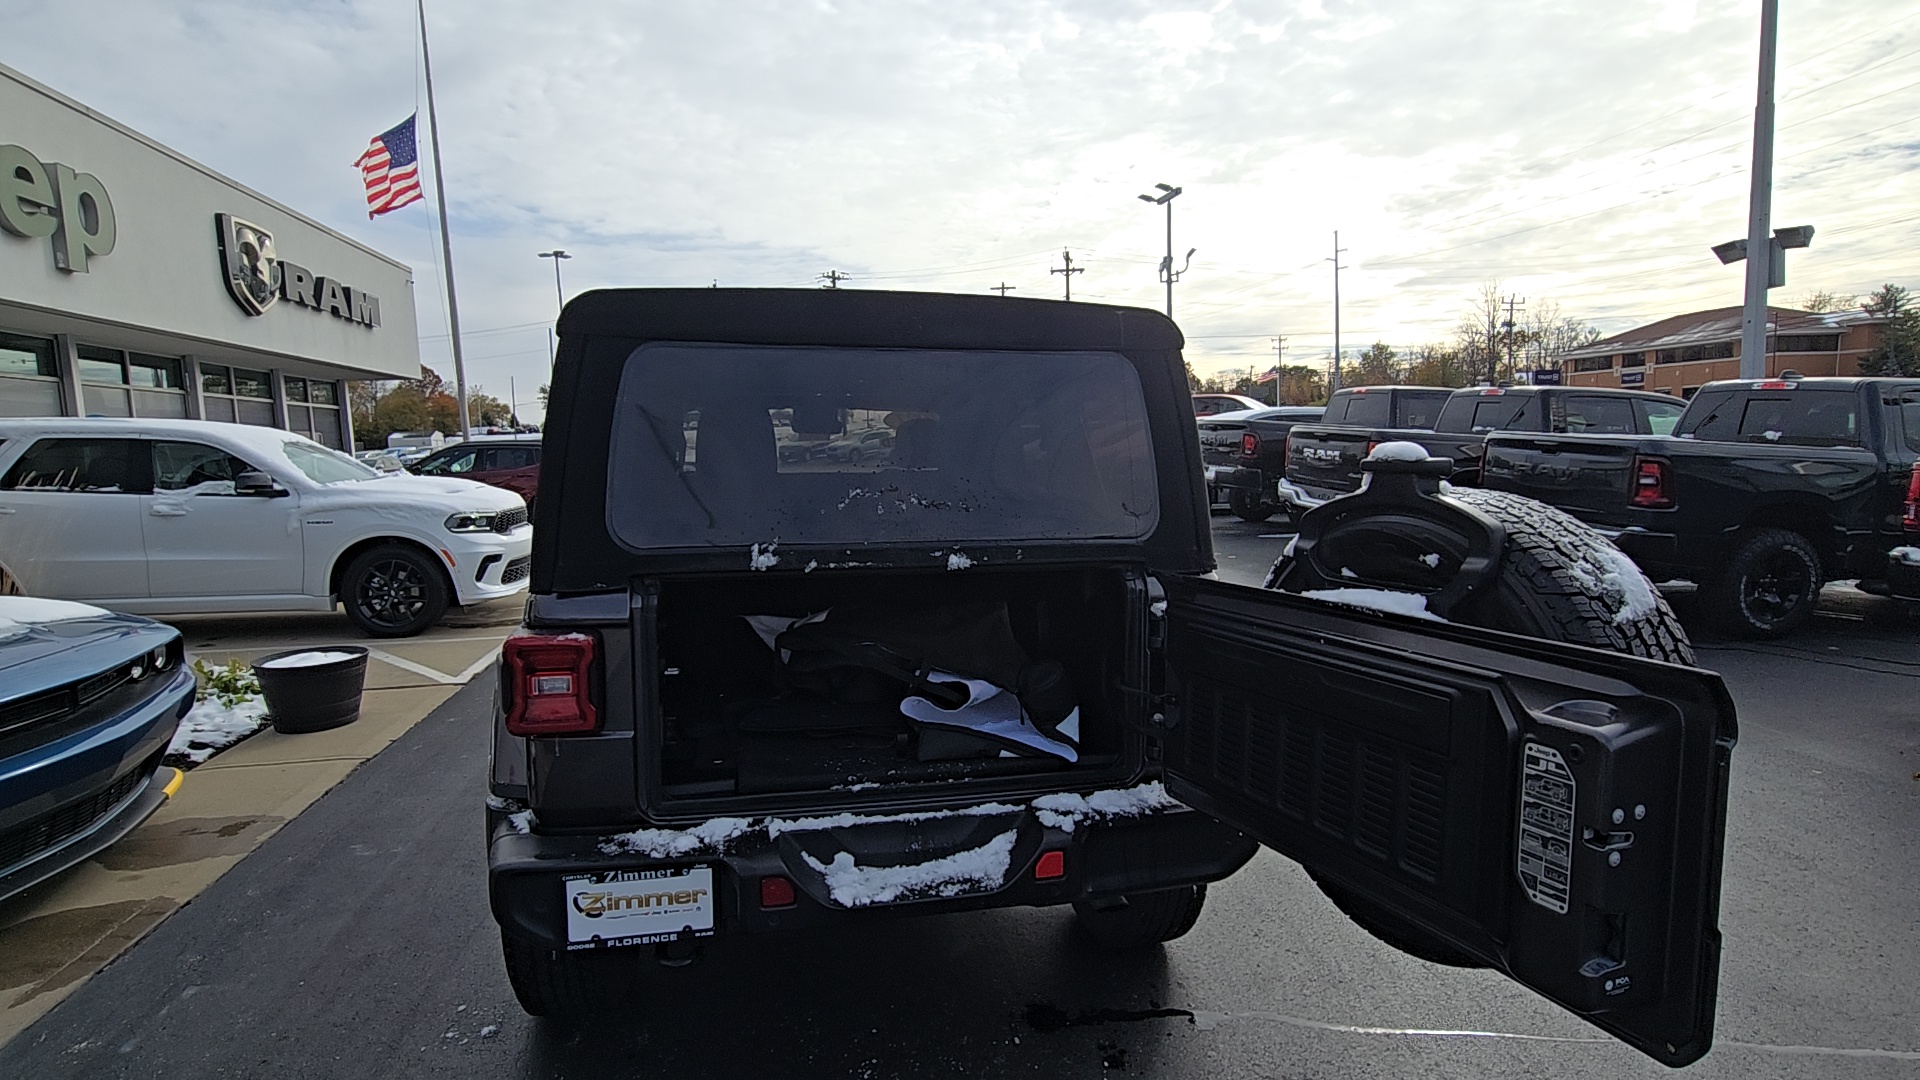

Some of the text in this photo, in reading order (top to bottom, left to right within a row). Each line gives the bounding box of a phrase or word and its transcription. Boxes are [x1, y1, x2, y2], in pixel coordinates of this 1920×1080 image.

[279, 260, 382, 329] RAM
[1303, 447, 1342, 461] RAM
[1533, 746, 1551, 757] Jeep
[603, 868, 675, 884] Zimmer
[578, 888, 708, 914] Zimmer
[566, 942, 596, 950] DODGE
[607, 933, 678, 948] FLORENCE
